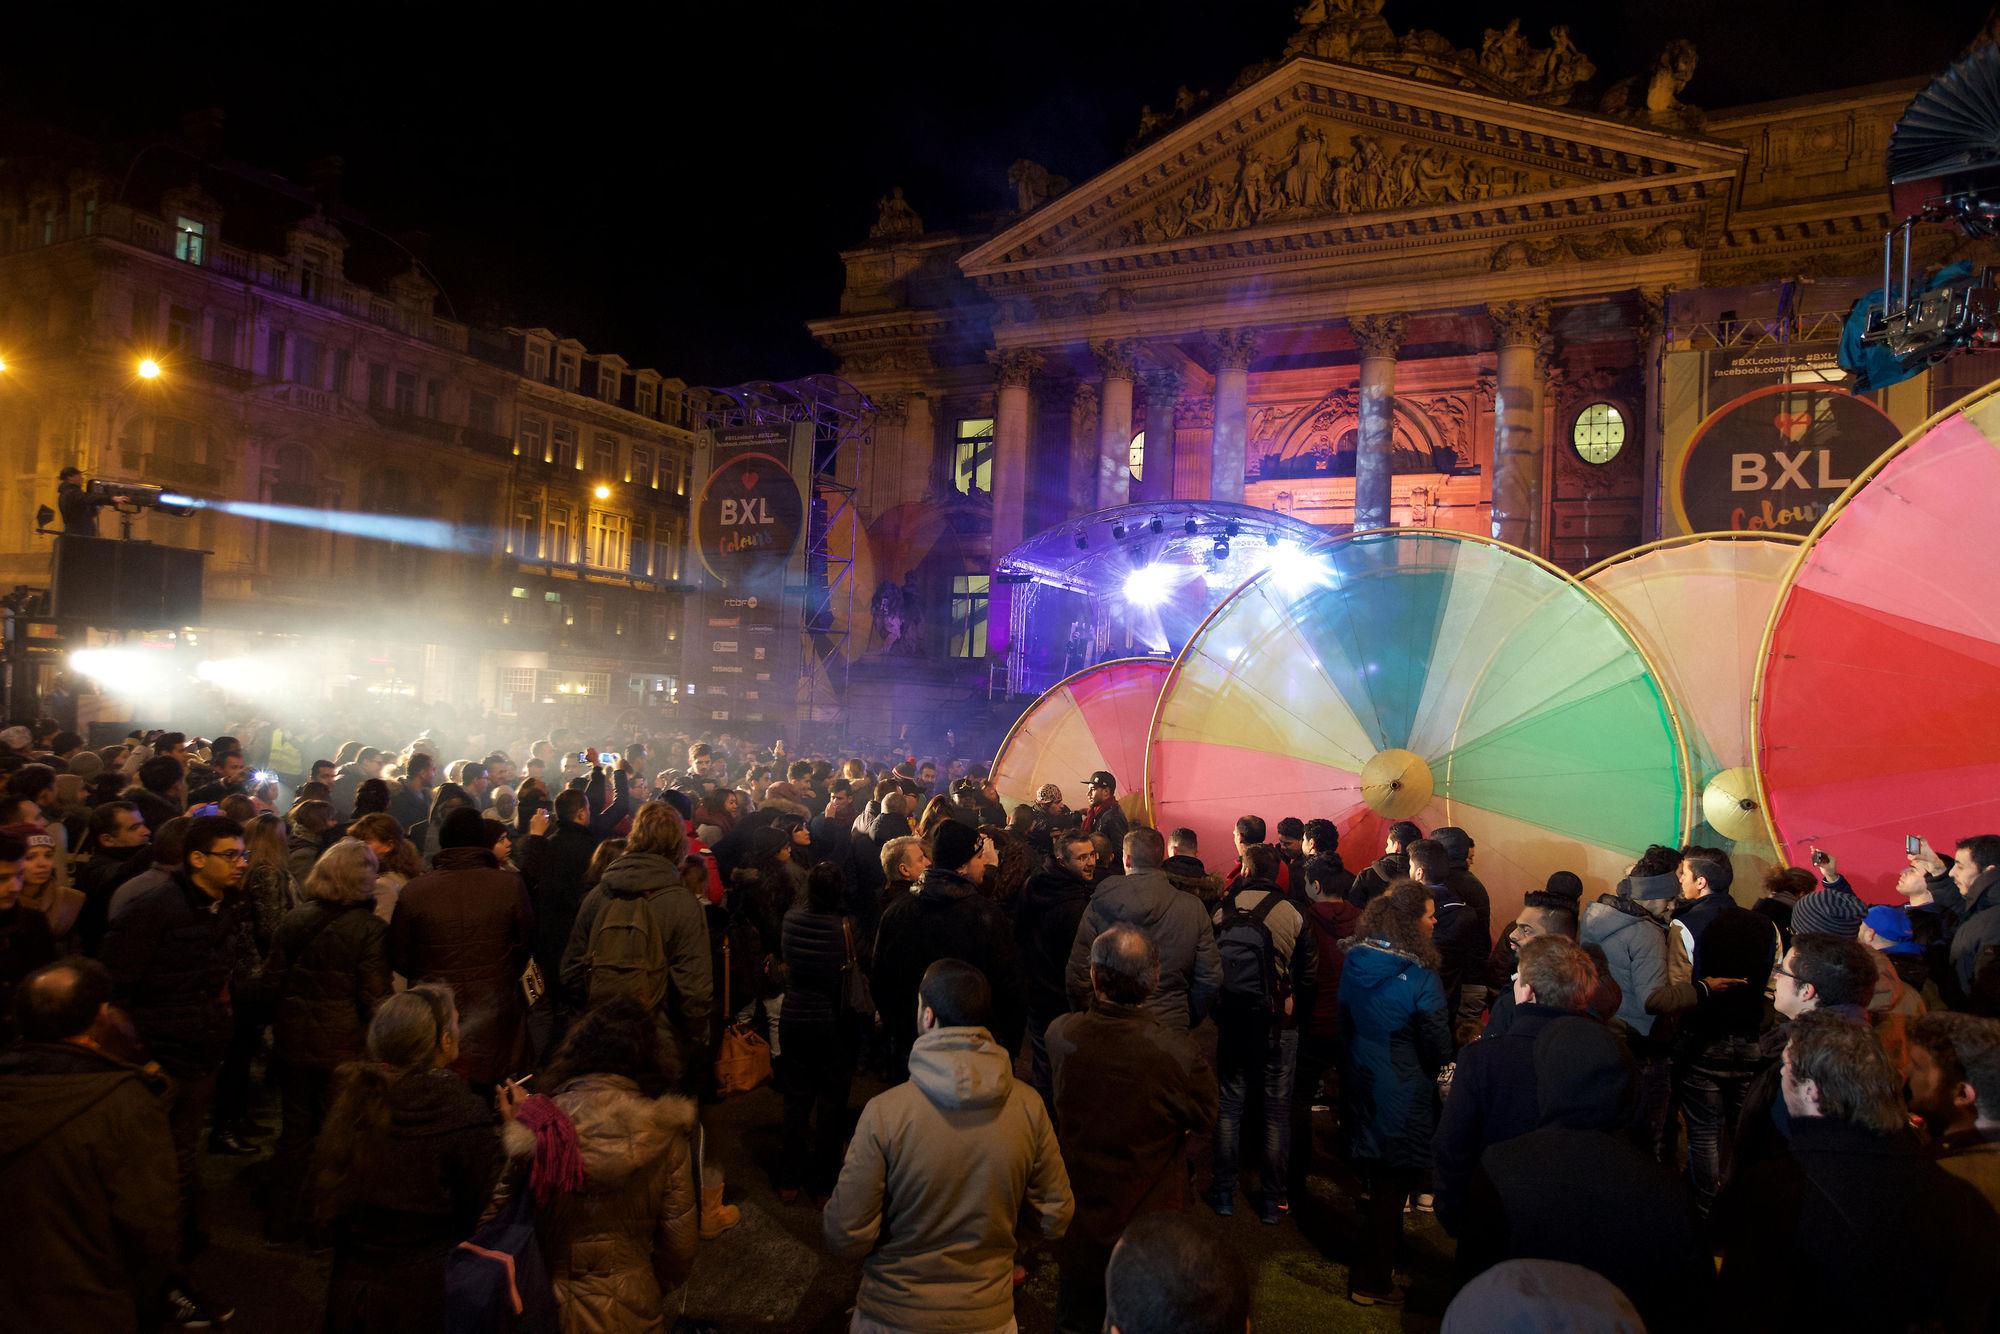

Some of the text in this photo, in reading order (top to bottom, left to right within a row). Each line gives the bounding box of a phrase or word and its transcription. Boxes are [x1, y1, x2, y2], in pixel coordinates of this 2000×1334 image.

[1731, 355, 1796, 366] #BXLcolours
[1806, 352, 1837, 361] #BXL
[1731, 449, 1851, 492] BXL
[720, 497, 774, 526] BXL
